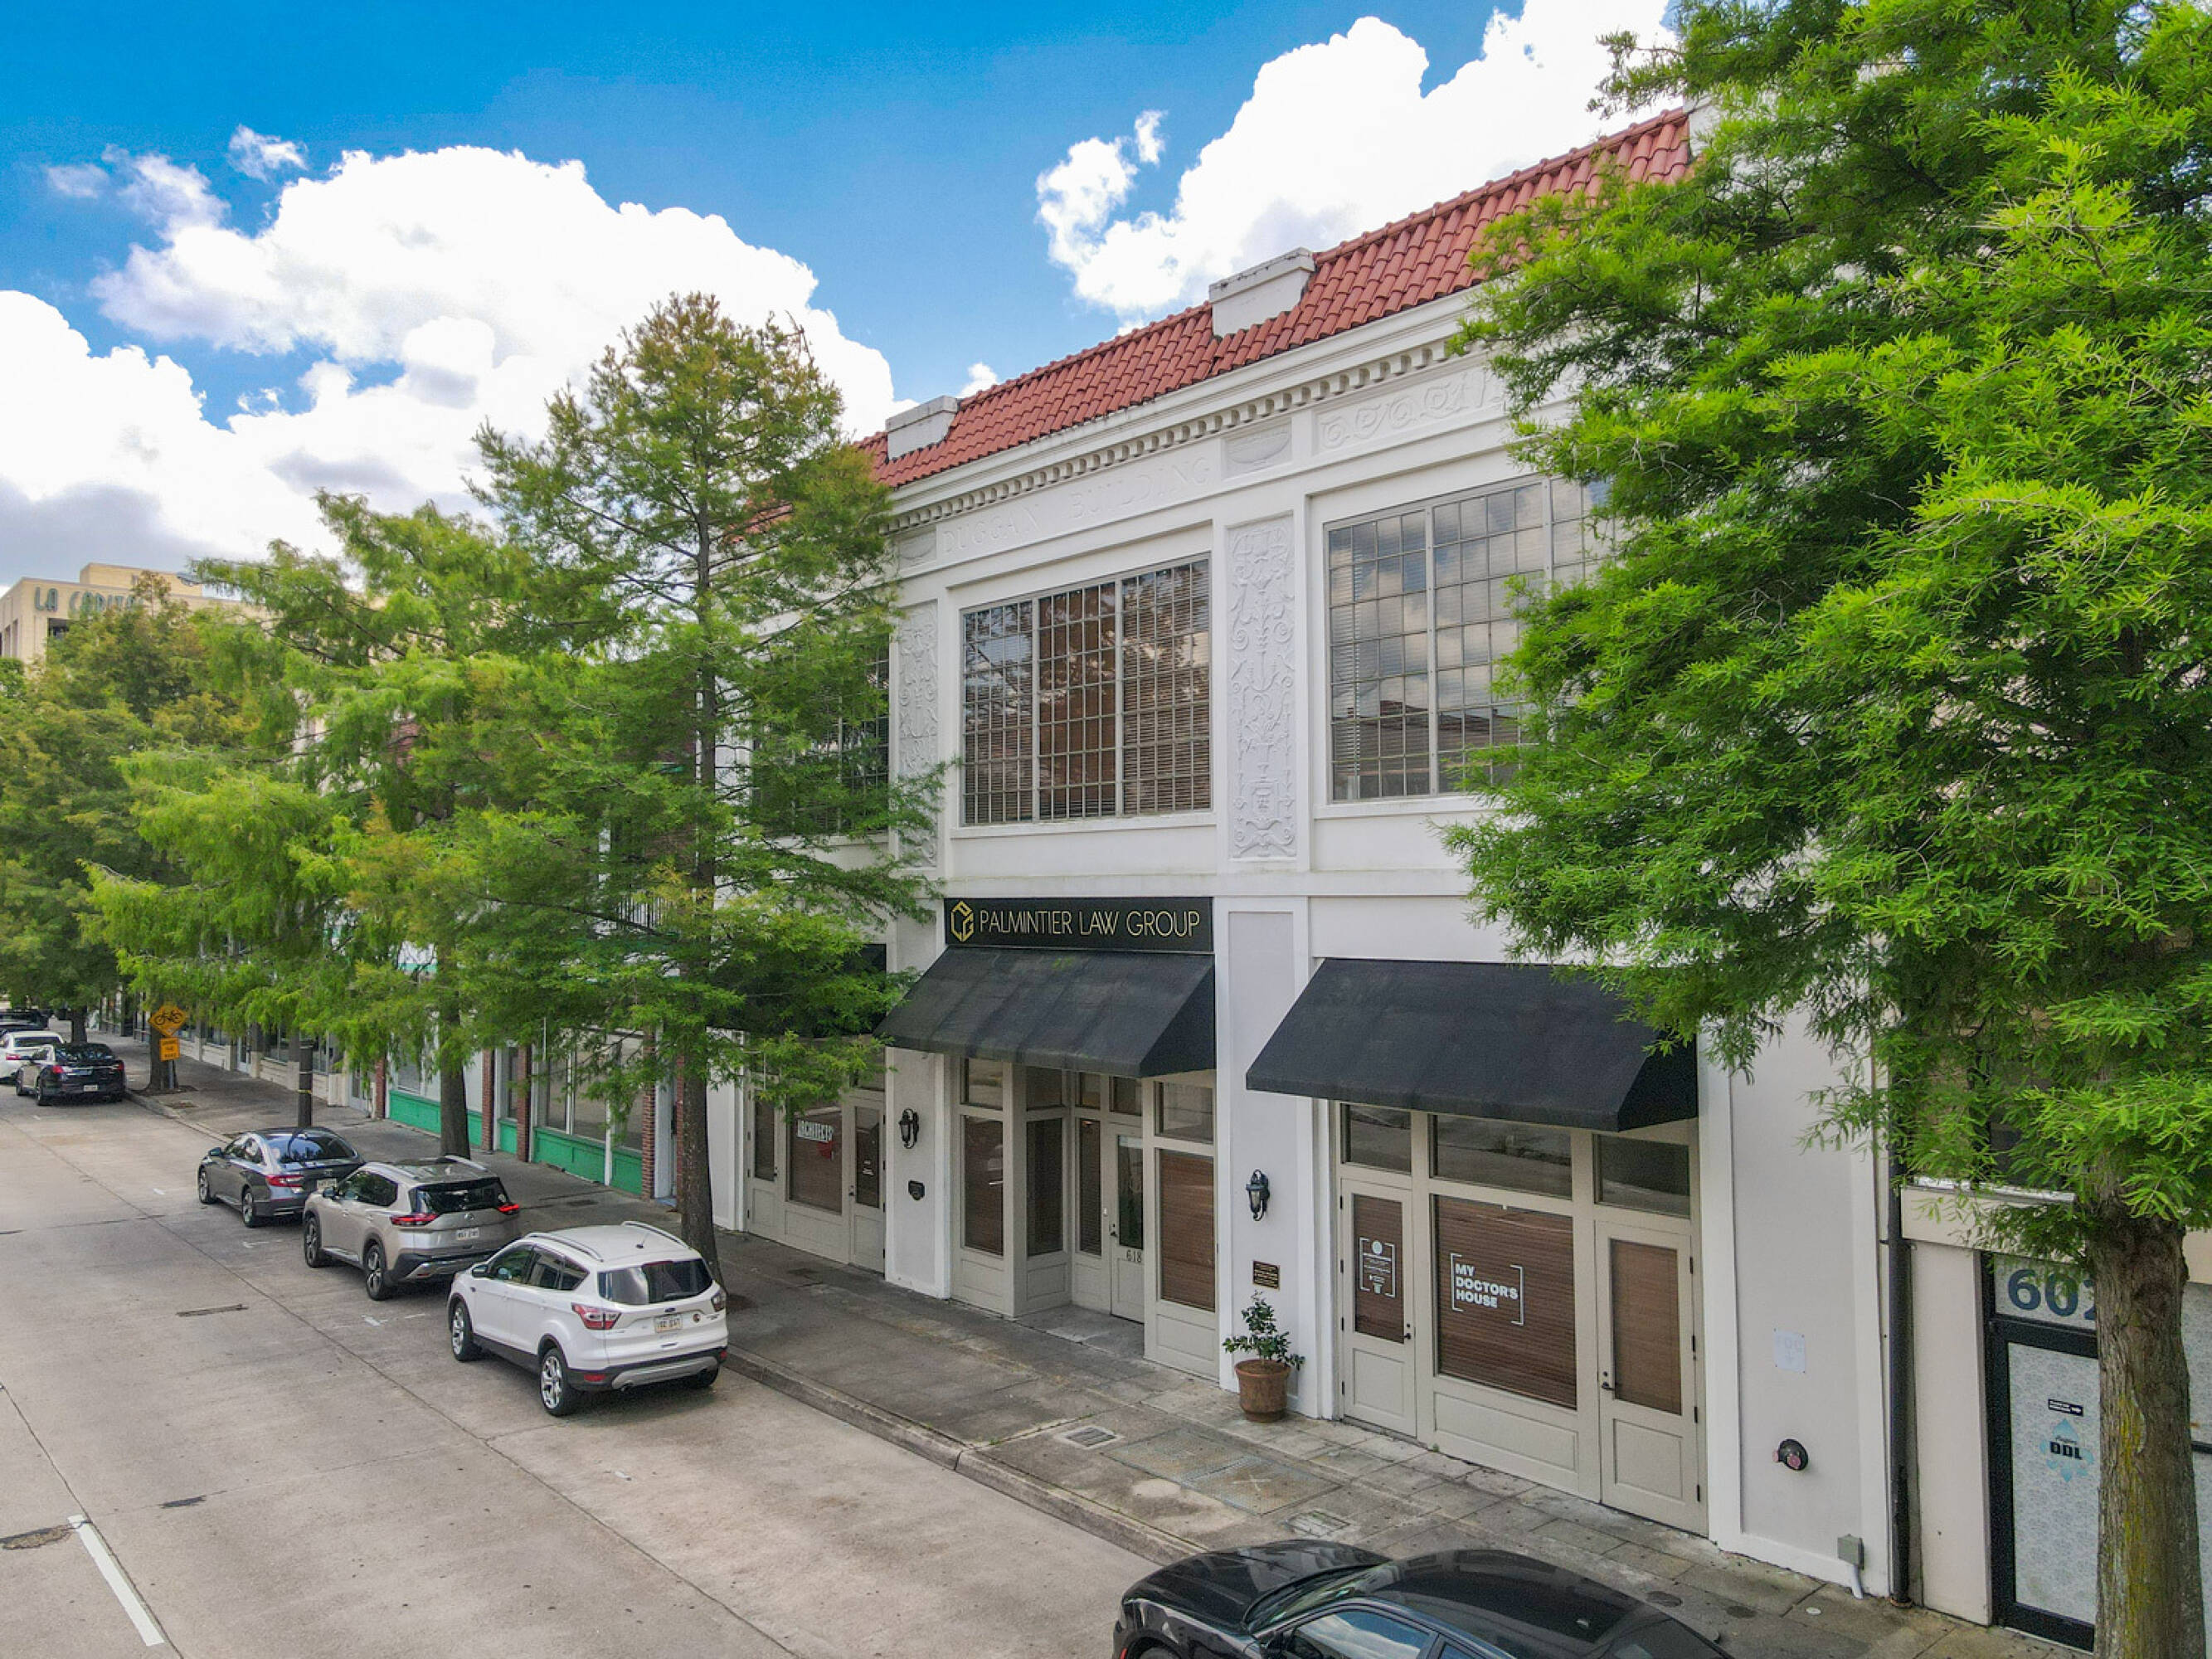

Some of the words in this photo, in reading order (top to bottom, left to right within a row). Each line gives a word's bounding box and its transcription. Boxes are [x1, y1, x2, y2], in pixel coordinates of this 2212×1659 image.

[35, 586, 58, 612] LA
[980, 910, 1073, 936] PALMINTIER
[1079, 911, 1120, 937] LAW
[1126, 910, 1200, 938] GROUP
[1456, 1263, 1475, 1277] MY
[1456, 1276, 1519, 1300] DOCTORS
[1456, 1289, 1498, 1309] HOUSE
